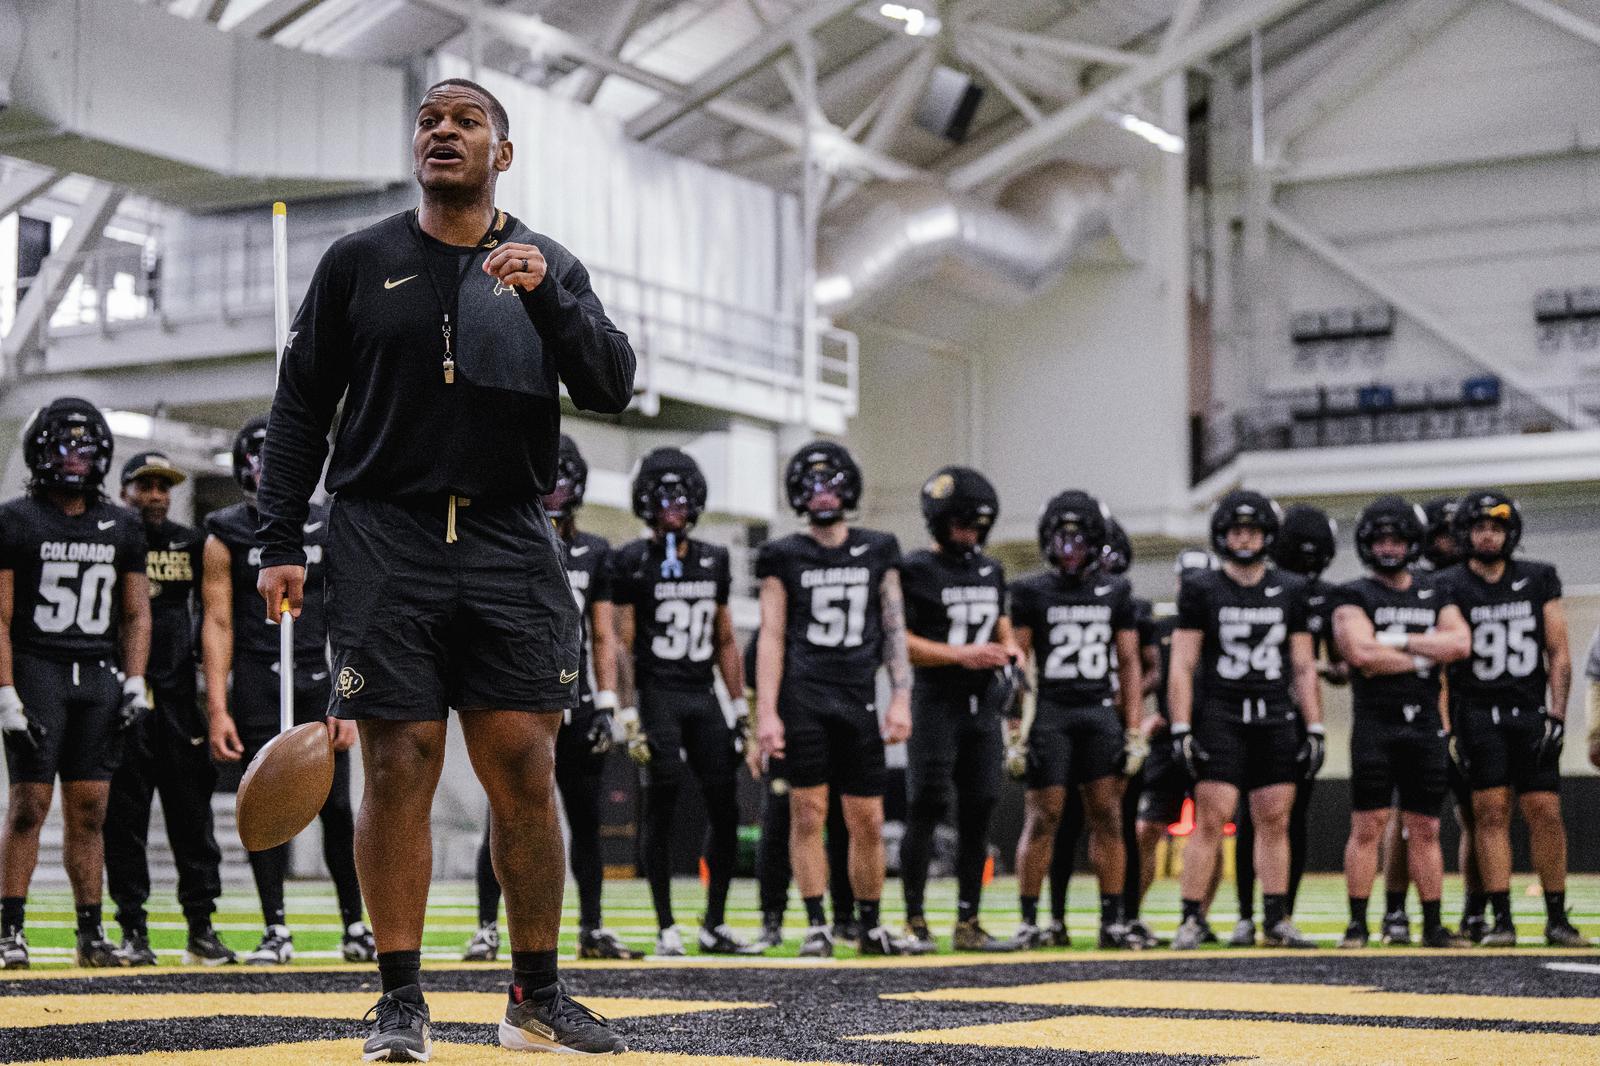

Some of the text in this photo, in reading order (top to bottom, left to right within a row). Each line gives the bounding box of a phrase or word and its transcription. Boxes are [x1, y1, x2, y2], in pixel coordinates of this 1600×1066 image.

[40, 541, 115, 563] COLORADO
[33, 561, 117, 634] 50
[806, 585, 869, 647] 51
[947, 603, 999, 645] 17
[651, 599, 717, 662] 30
[1216, 622, 1287, 680] 54
[1472, 616, 1538, 681] 95
